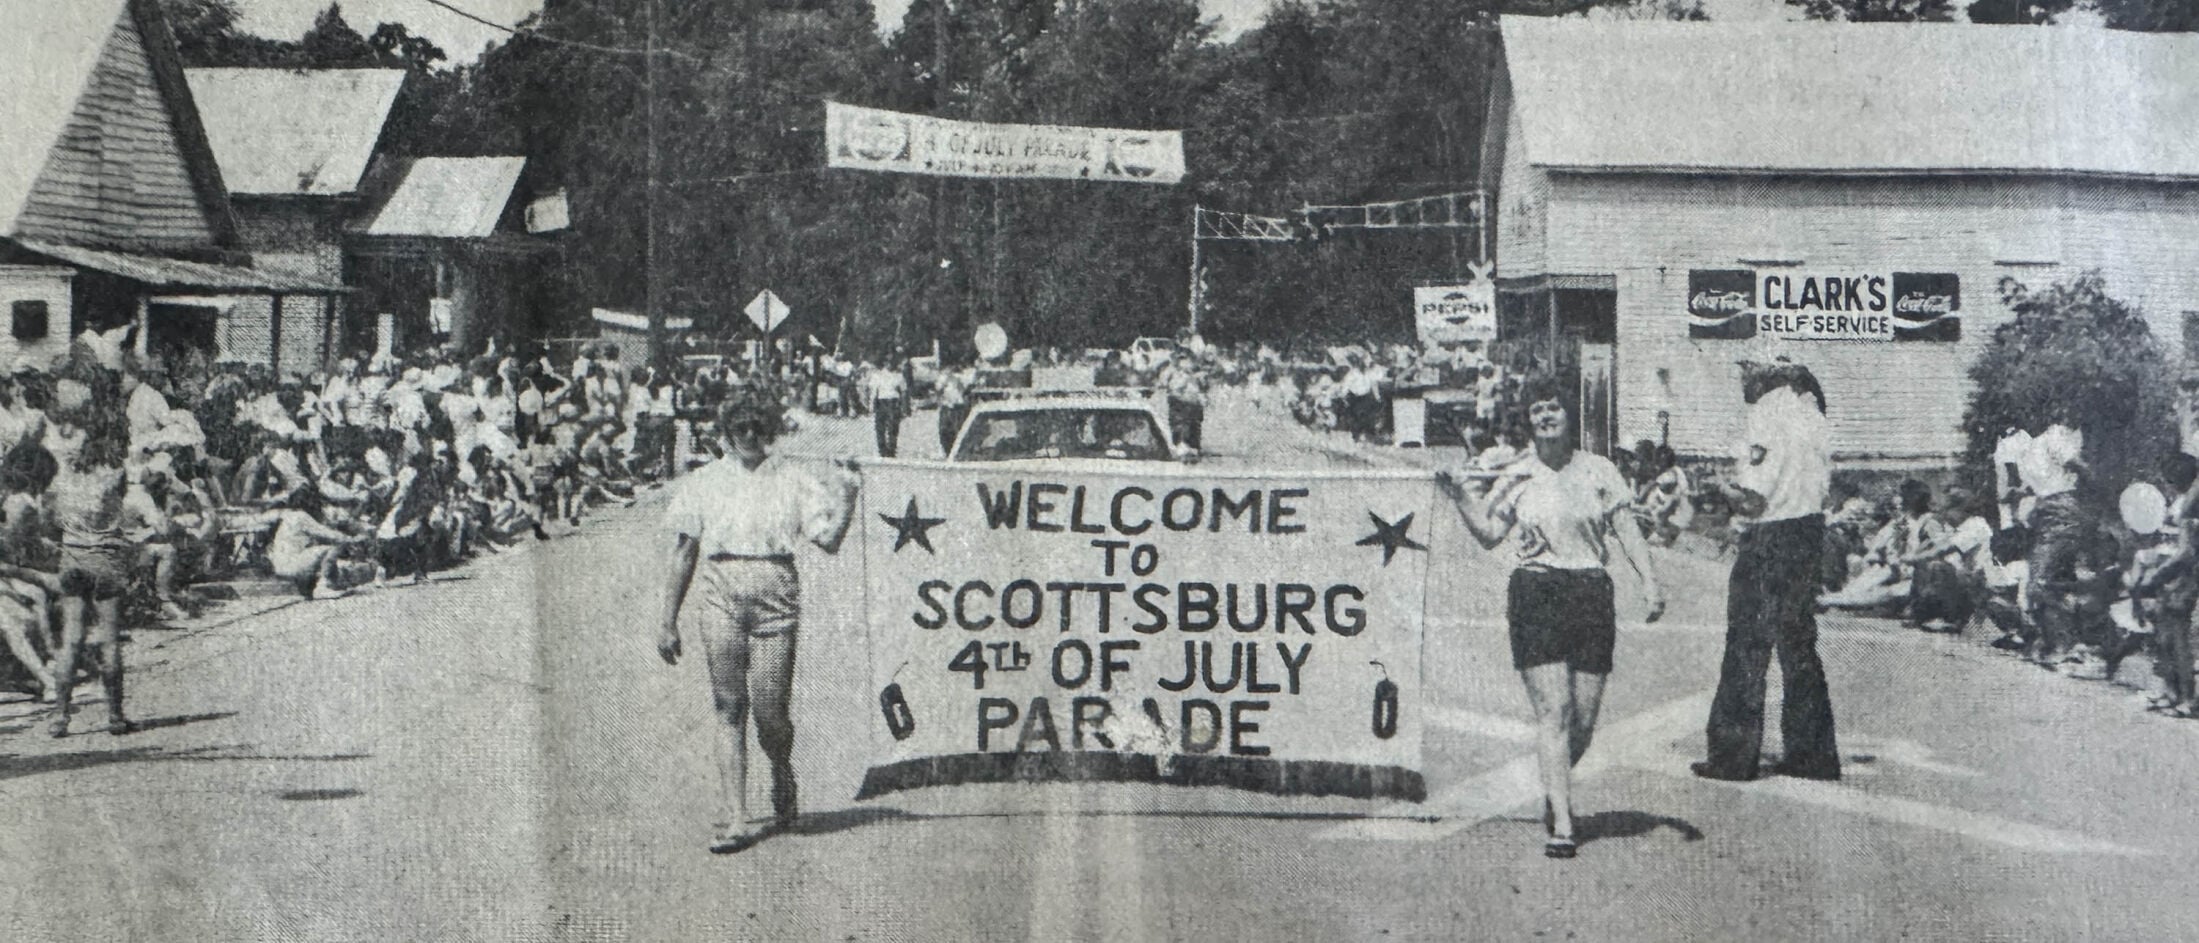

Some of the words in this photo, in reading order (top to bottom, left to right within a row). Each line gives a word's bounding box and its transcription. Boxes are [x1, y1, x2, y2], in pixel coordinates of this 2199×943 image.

[1422, 303, 1489, 315] PEPSI
[1764, 273, 1887, 312] CLARK'S
[976, 480, 1309, 535] WELCOME
[1091, 540, 1159, 577] TO
[912, 579, 1367, 637] SCOTTSBURG
[1051, 639, 1141, 692] OF
[1157, 639, 1312, 695] JULY
